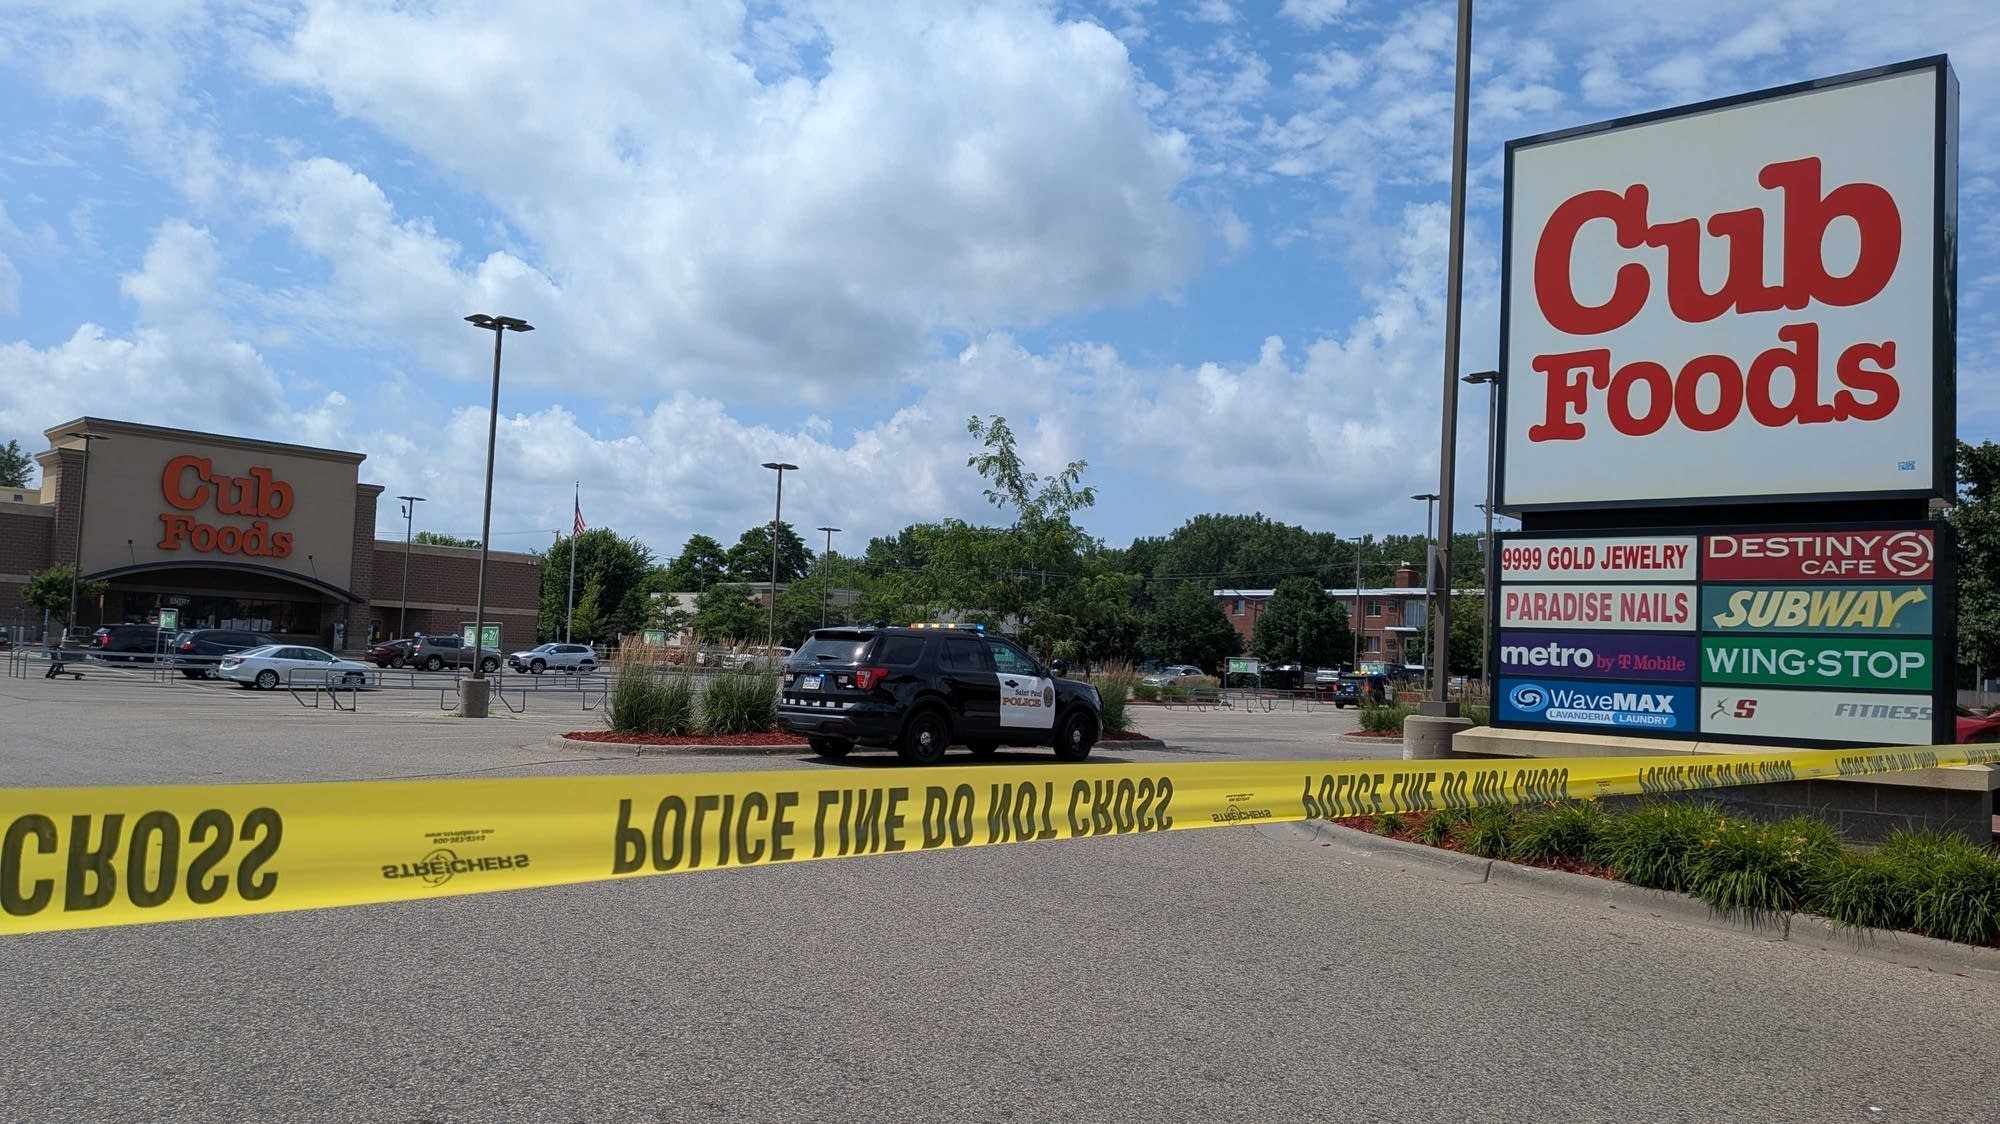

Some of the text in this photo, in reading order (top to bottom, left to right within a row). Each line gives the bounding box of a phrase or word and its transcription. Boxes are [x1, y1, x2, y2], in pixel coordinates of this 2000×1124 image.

[1534, 156, 1901, 335] Cub
[1528, 322, 1900, 442] Foods
[162, 455, 294, 520] Cub
[157, 513, 293, 558] Foods
[1709, 535, 1882, 558] DESTINY
[1502, 545, 1688, 570] 9999 GOLD JEWELRY
[1801, 560, 1876, 575] CAFE
[1506, 592, 1689, 623] PARADISE NAILS
[1713, 587, 1927, 629] SUBWAY
[1501, 642, 1594, 668] metro
[1597, 654, 1615, 672] by
[1002, 697, 1041, 707] POLICE
[1550, 689, 1674, 713] WaveMAX
[1734, 699, 1932, 721] S FITNESS
[1549, 710, 1669, 725] LAVANDERIA LAUNDRY
